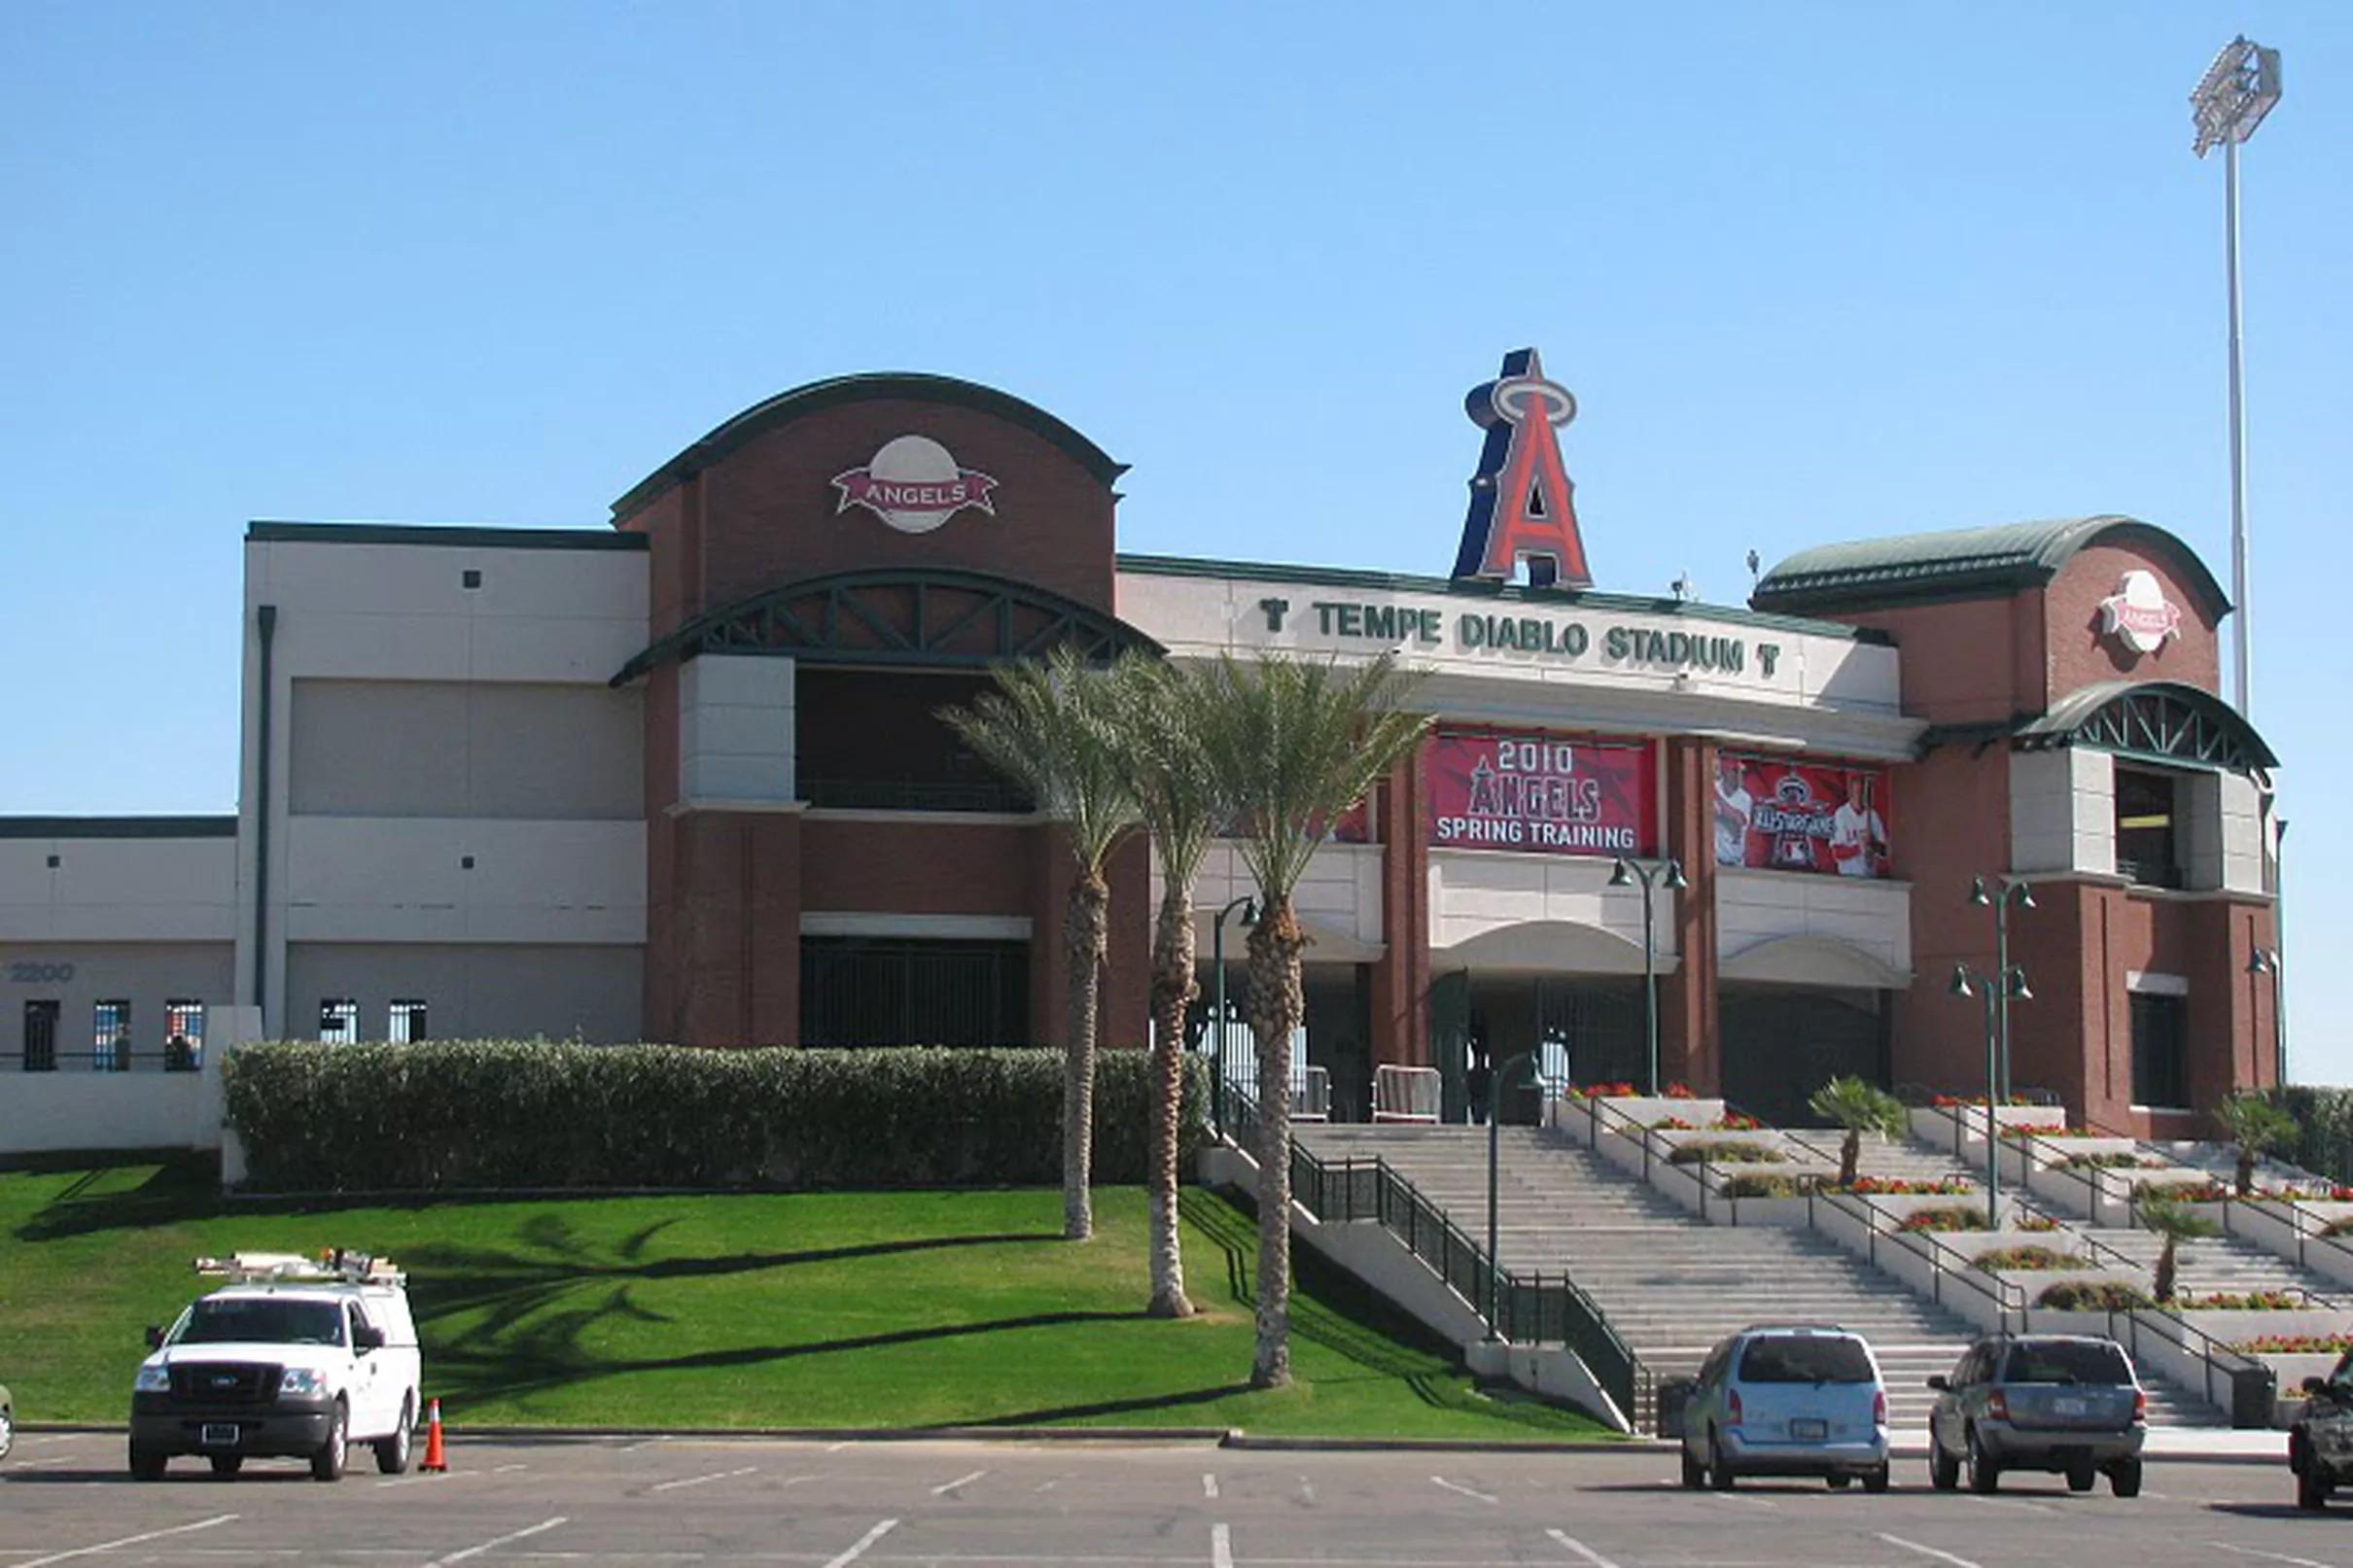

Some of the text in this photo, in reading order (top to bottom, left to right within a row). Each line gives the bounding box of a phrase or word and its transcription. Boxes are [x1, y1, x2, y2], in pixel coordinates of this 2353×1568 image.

[1478, 347, 1596, 588] A
[865, 483, 966, 505] ANGELS
[1311, 601, 1442, 644] TEMPE
[1460, 612, 1589, 657] DIABLO
[1606, 625, 1744, 673] STADIUM
[1498, 742, 1573, 773] 2010
[1469, 754, 1600, 822] ANGELS
[1436, 816, 1635, 849] SPRING TRAINING
[11, 962, 73, 983] 2200
